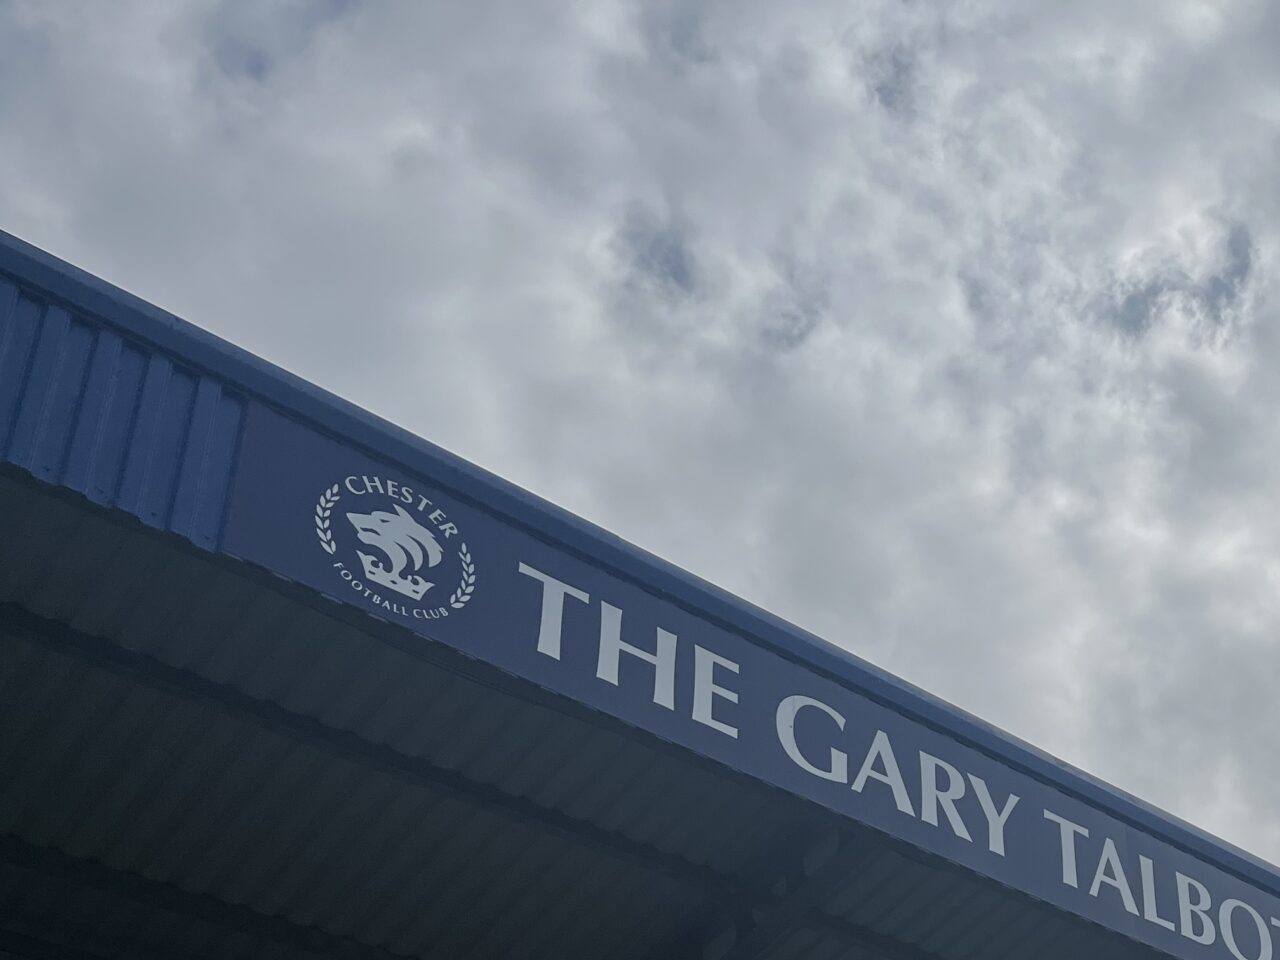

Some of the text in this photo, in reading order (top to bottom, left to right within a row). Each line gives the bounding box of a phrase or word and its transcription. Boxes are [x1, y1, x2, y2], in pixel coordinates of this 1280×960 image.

[344, 475, 459, 539] CHESTER
[333, 562, 449, 620] FOOTBALL CLUB
[518, 561, 741, 740] THE
[775, 695, 1020, 857] GARY
